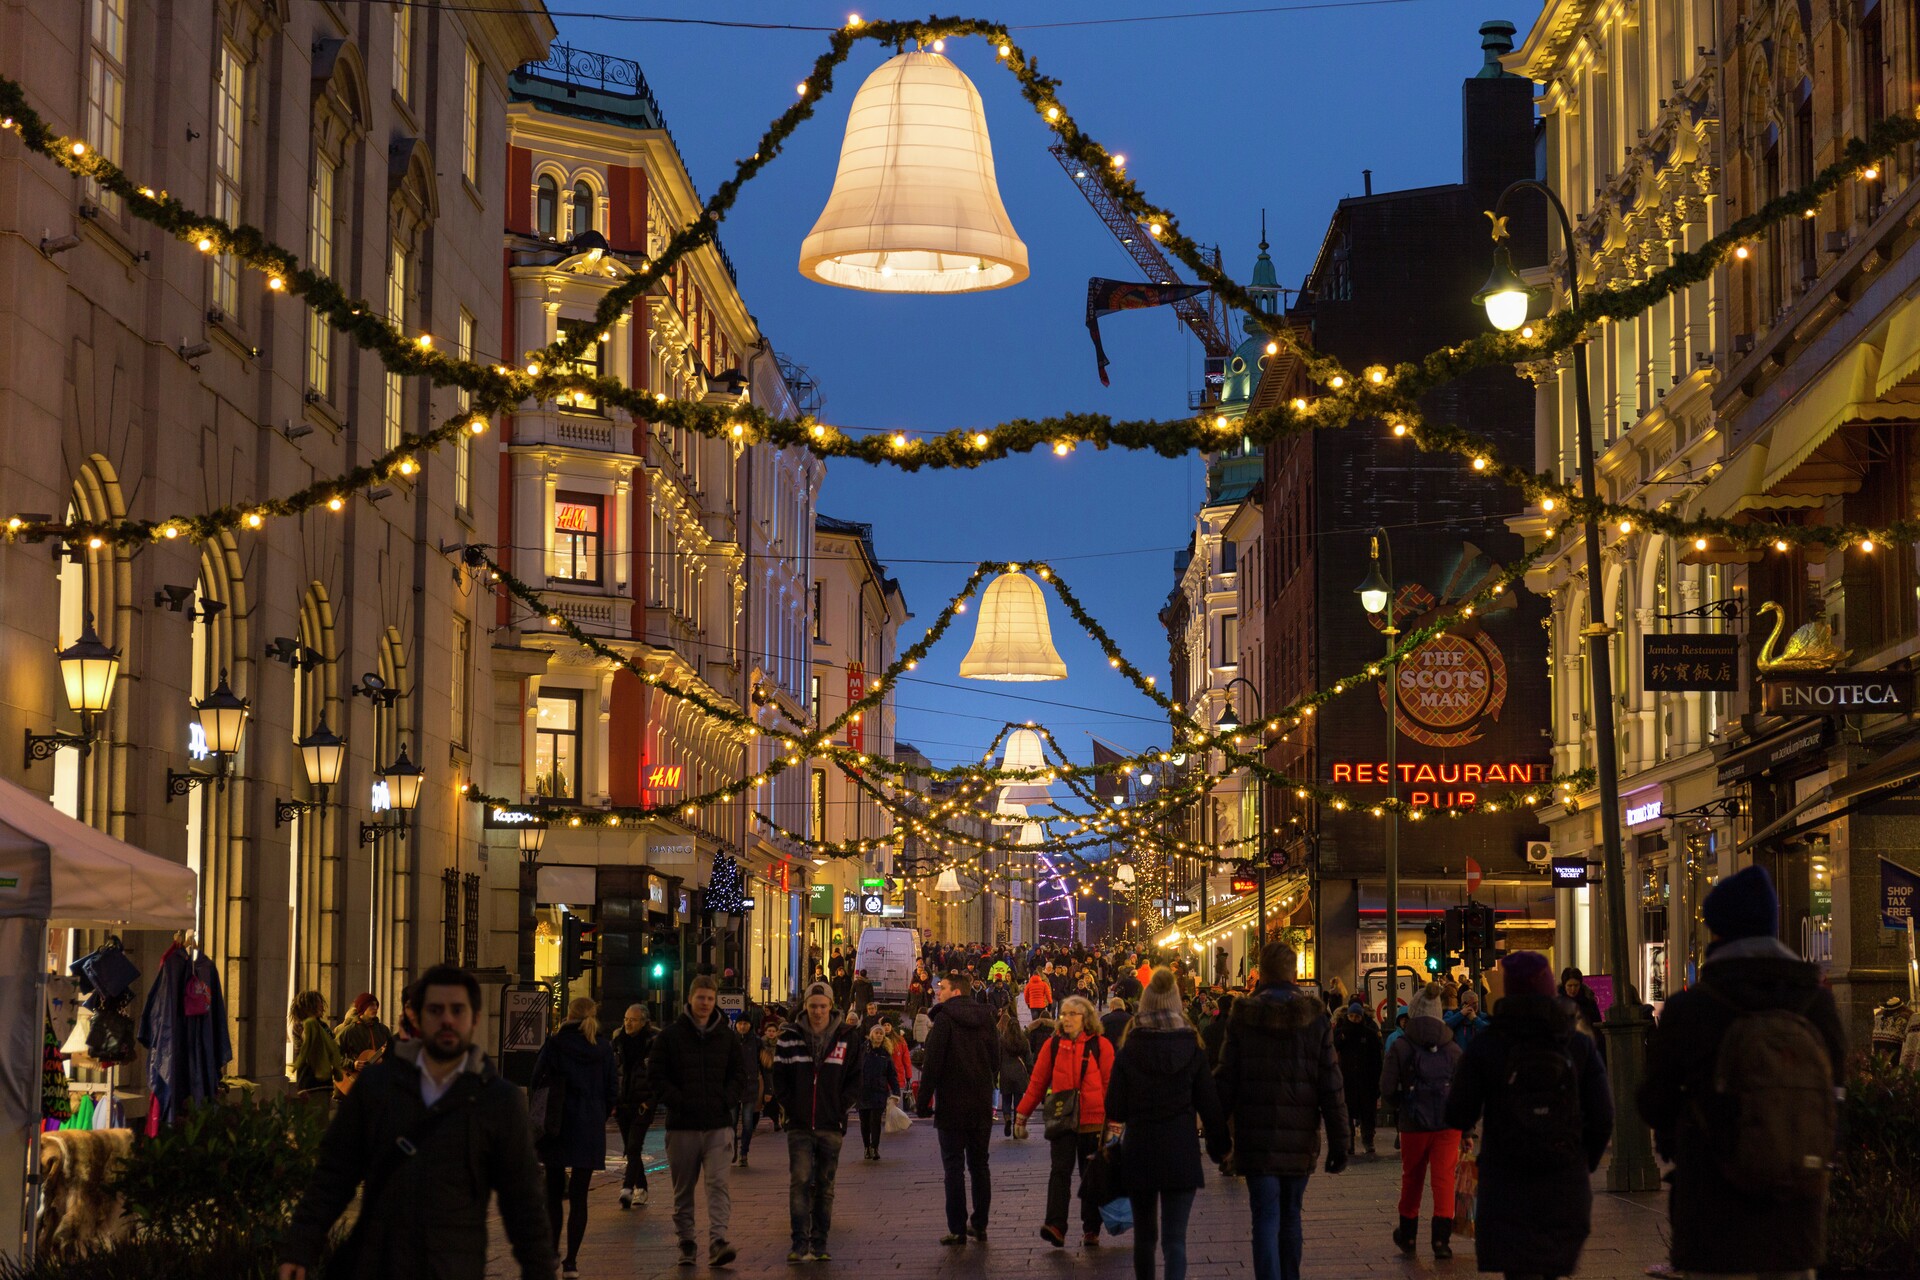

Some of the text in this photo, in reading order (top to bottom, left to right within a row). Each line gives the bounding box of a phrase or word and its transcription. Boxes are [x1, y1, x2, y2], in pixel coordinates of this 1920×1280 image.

[557, 506, 586, 529] H&M
[1648, 644, 1734, 655] Jambo Restaurant
[1420, 651, 1464, 666] THE
[1400, 670, 1485, 689] SCOTS
[1420, 692, 1470, 707] MAN
[1781, 683, 1900, 706] ENOTECA
[648, 765, 682, 789] H&M
[1411, 791, 1477, 811] PUB
[649, 845, 693, 854] MANGO
[1887, 886, 1914, 896] SHOP
[1887, 897, 1906, 906] TAX
[1887, 907, 1912, 916] FREE
[721, 996, 741, 1005] Sone
